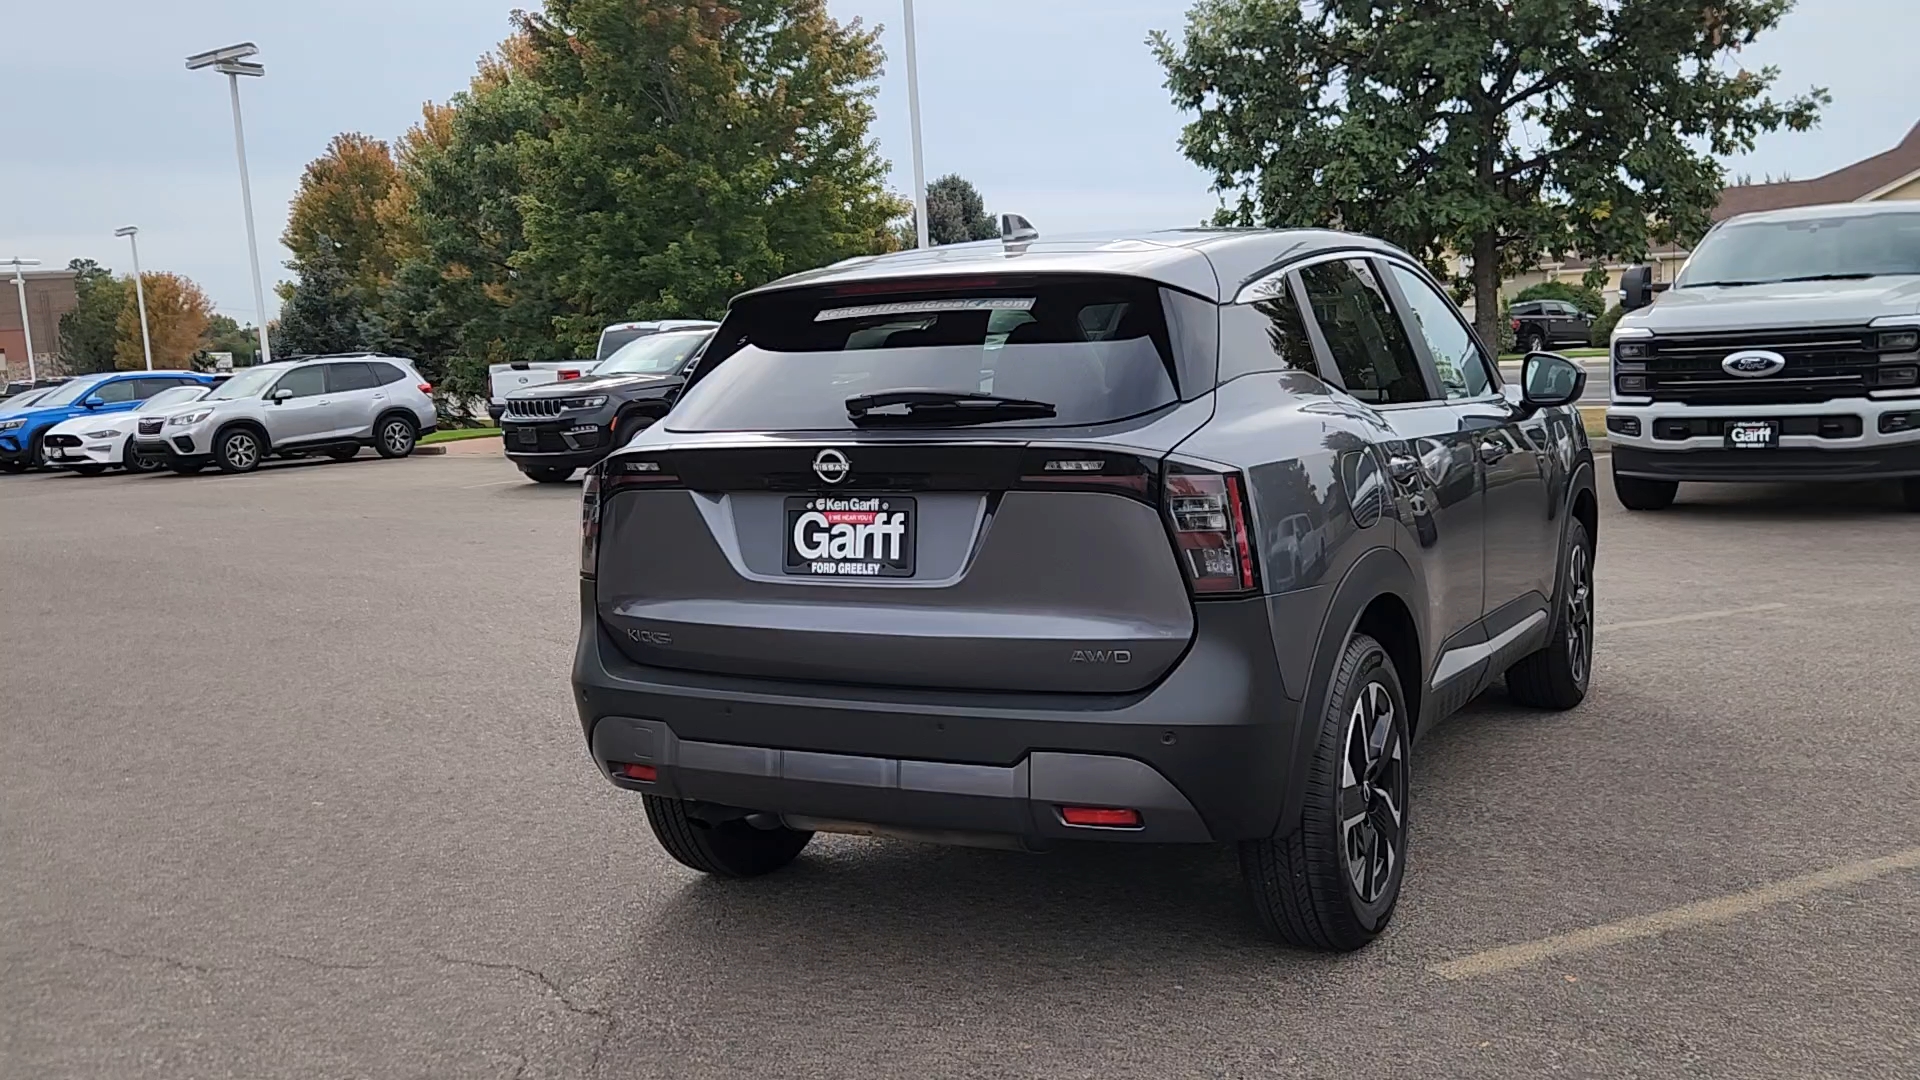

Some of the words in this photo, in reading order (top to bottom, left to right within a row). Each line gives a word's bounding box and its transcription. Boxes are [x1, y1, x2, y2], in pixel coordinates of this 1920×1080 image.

[1738, 357, 1768, 370] Ford
[1731, 427, 1771, 442] Garff
[812, 462, 849, 471] NISSAN
[826, 498, 849, 511] Ken
[850, 498, 880, 511] Garff
[794, 511, 905, 560] Garff
[811, 562, 837, 574] FORD
[837, 562, 880, 575] GREELEY
[1069, 649, 1132, 663] AWD
